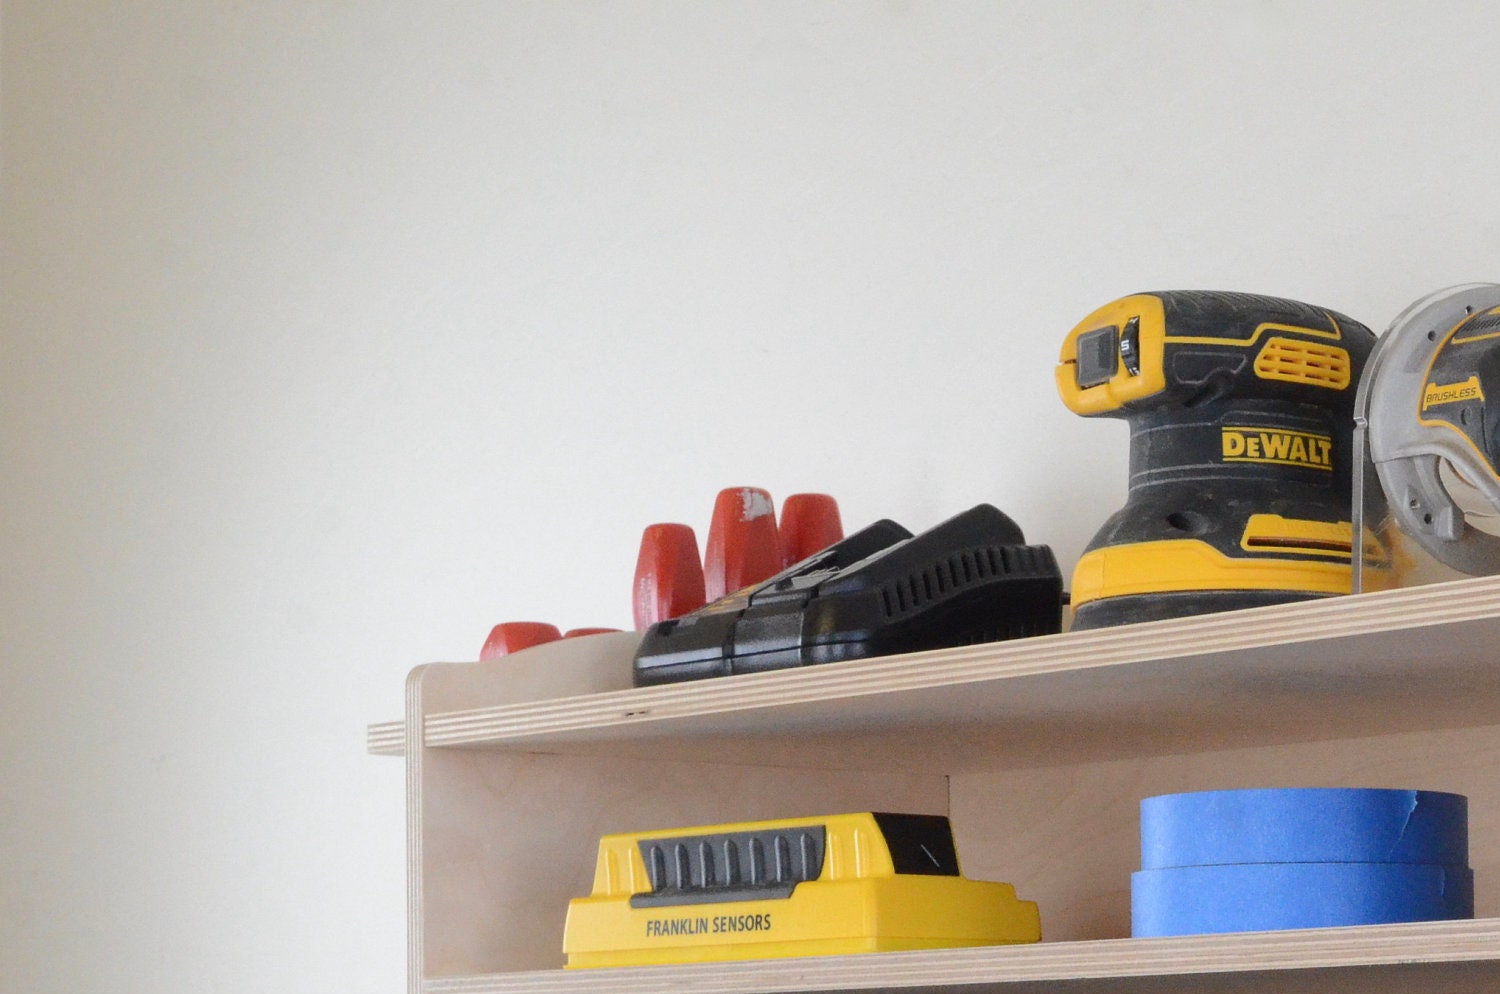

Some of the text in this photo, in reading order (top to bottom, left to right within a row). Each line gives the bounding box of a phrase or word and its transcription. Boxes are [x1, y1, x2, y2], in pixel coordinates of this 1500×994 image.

[1121, 340, 1130, 351] 5
[1426, 387, 1477, 403] BRUSHLESS
[1222, 431, 1332, 464] DEWALT
[646, 914, 771, 936] FRANKLIN SENSORS
